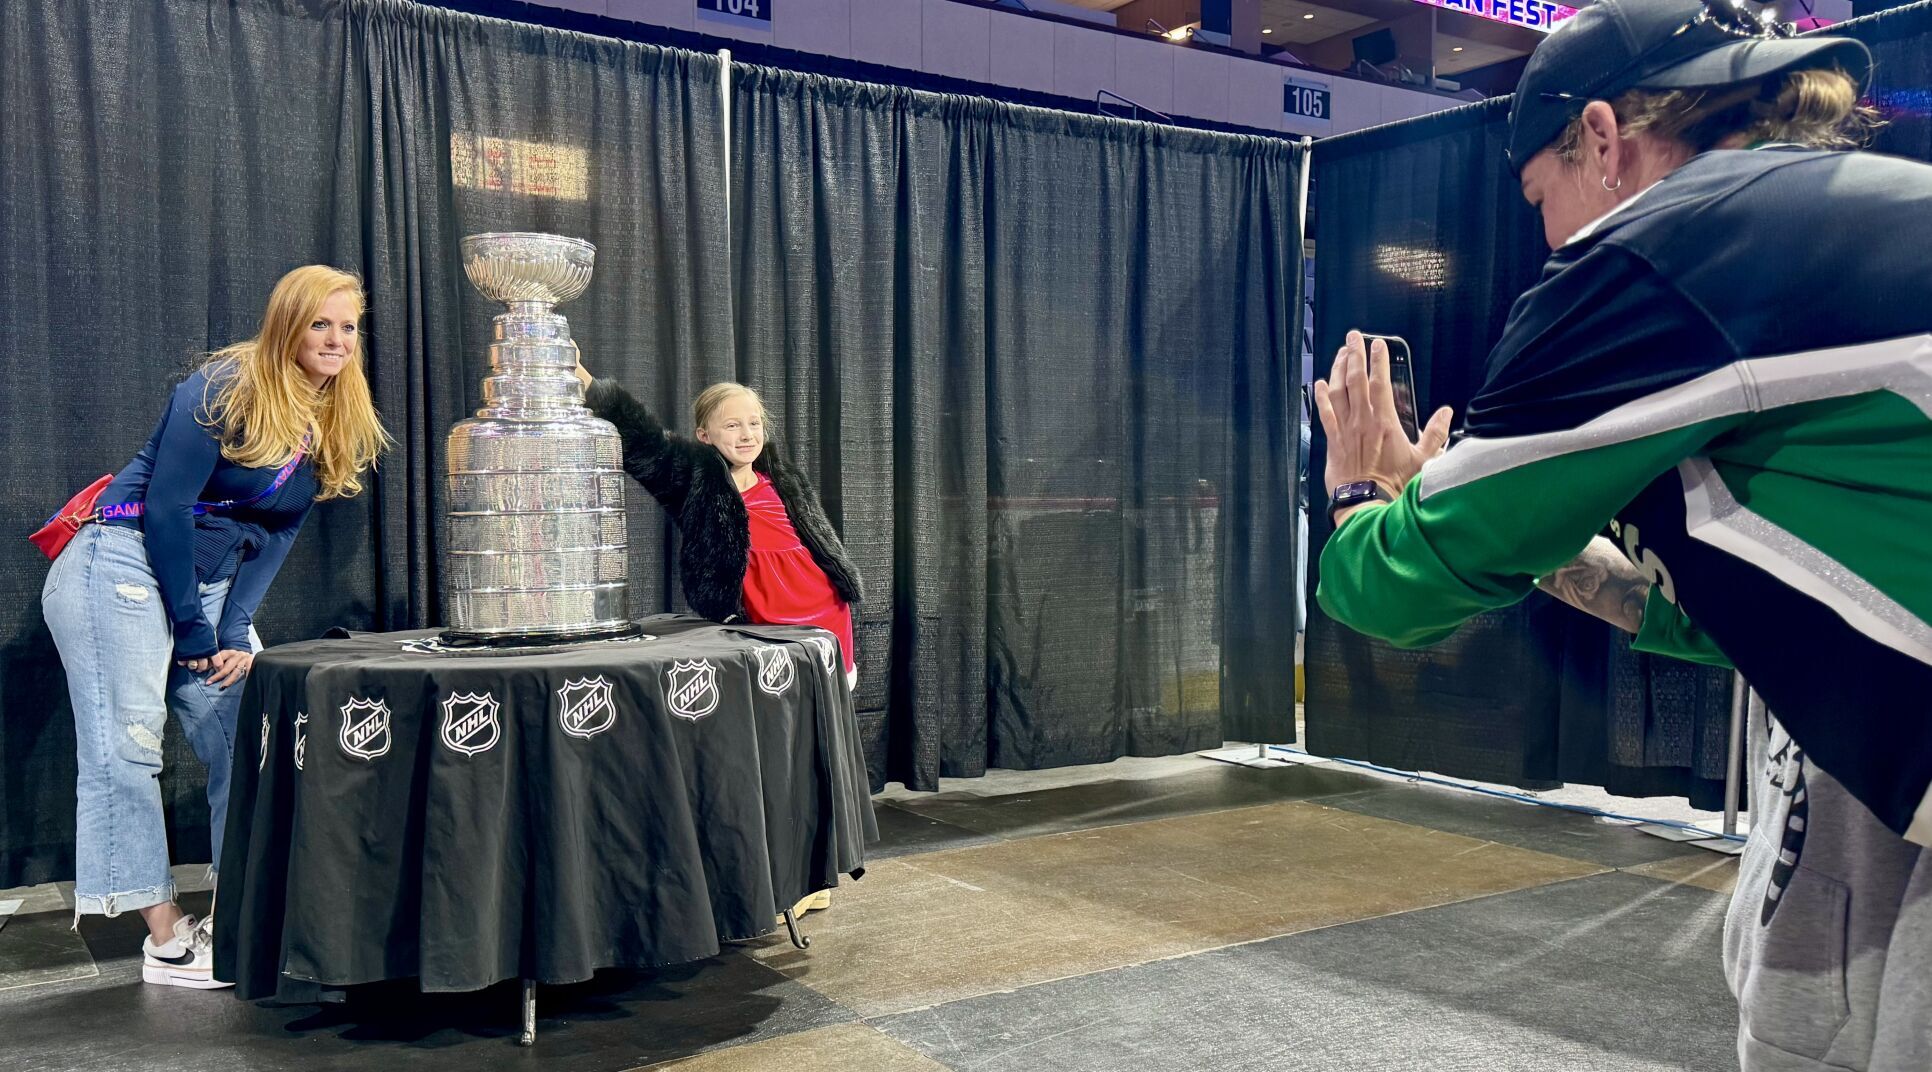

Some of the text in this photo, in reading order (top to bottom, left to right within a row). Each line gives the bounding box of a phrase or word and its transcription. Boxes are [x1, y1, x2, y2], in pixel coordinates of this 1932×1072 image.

[1491, 0, 1557, 29] FEST
[1292, 87, 1322, 117] 105
[766, 651, 785, 684] NHL
[679, 675, 708, 707] NHL
[455, 708, 490, 742] NHL
[571, 691, 604, 726] NHL
[353, 713, 384, 746] NHL
